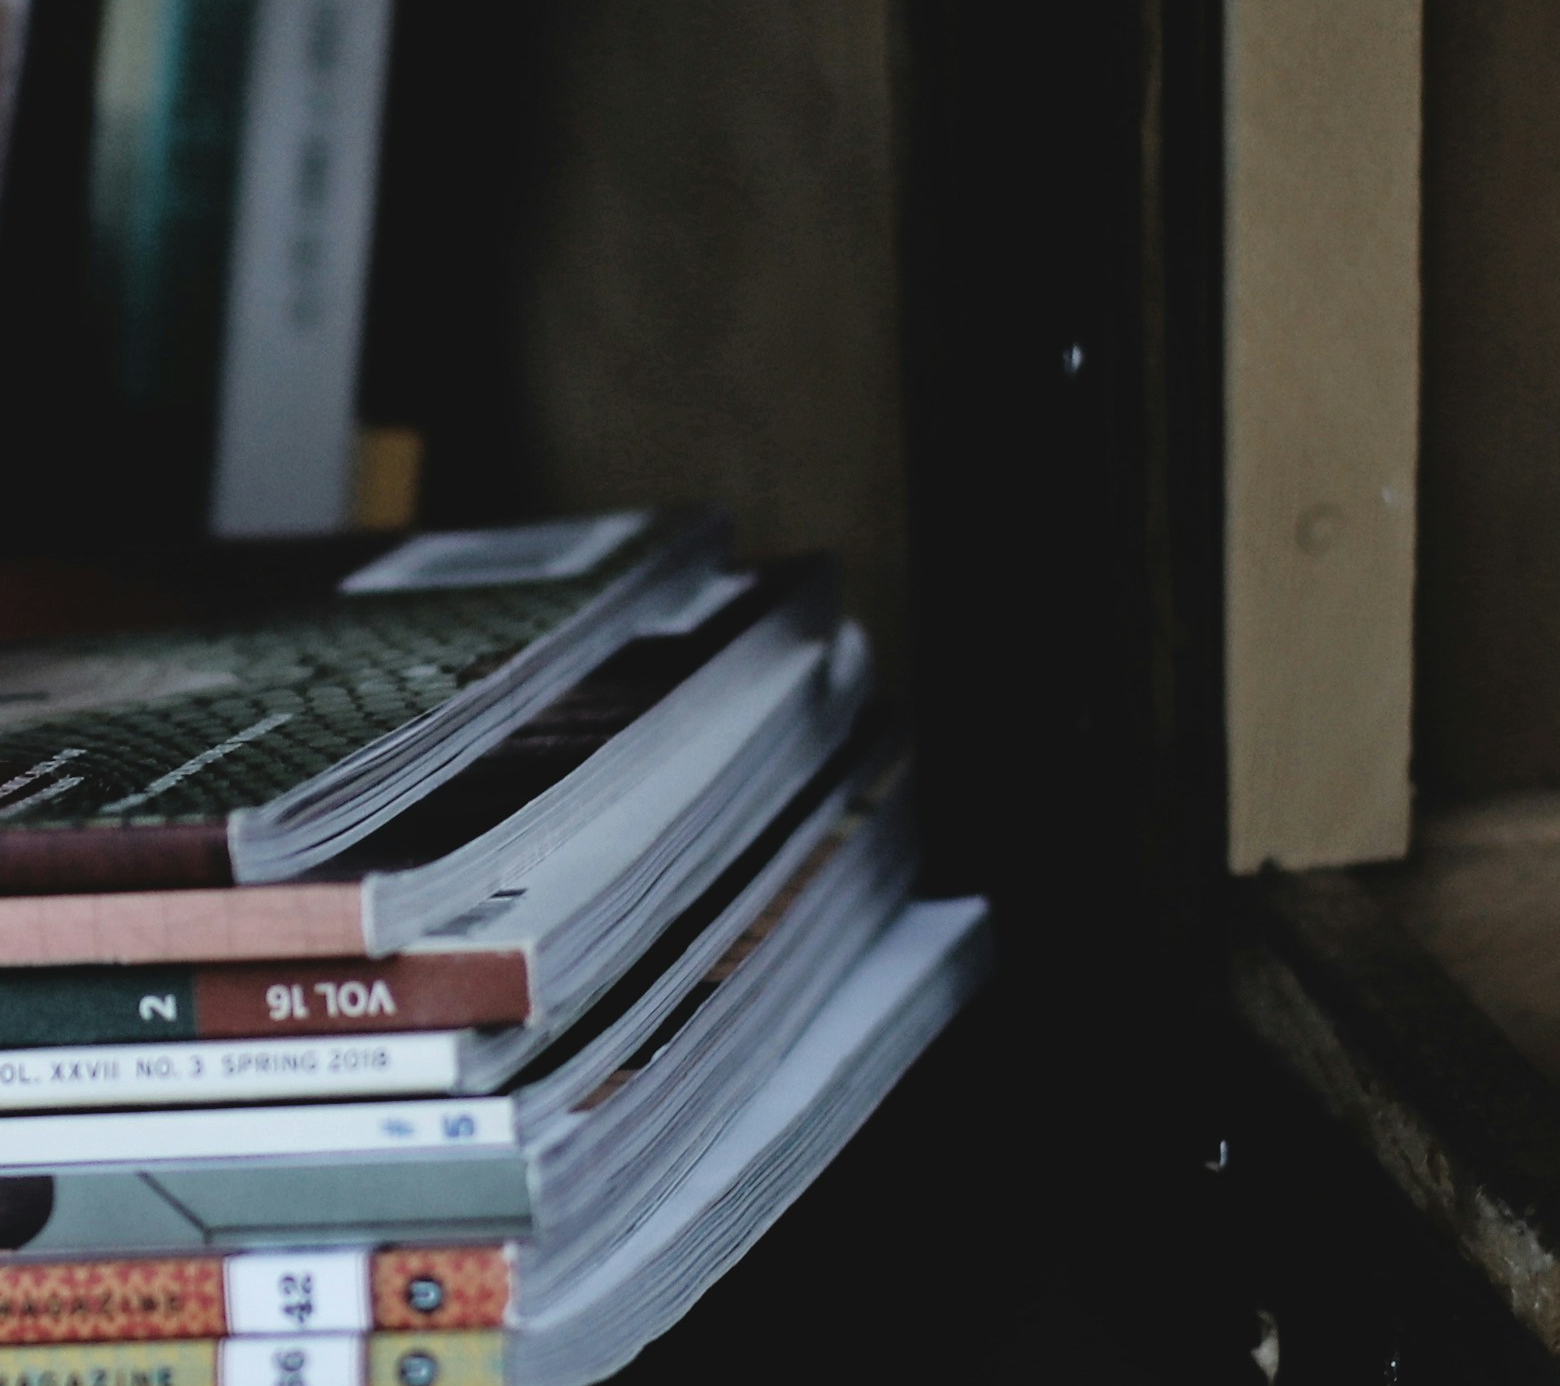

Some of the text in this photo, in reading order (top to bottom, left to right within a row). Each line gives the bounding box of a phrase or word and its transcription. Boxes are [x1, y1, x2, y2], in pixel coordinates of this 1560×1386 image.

[138, 992, 178, 1022] 2
[265, 979, 398, 1021] VOL 16
[49, 1059, 121, 1084] XXVII
[135, 1056, 181, 1081] NO.
[187, 1055, 204, 1076] 3
[221, 1052, 319, 1076] SPRING
[327, 1047, 390, 1072] 2018
[282, 1274, 314, 1324] 42
